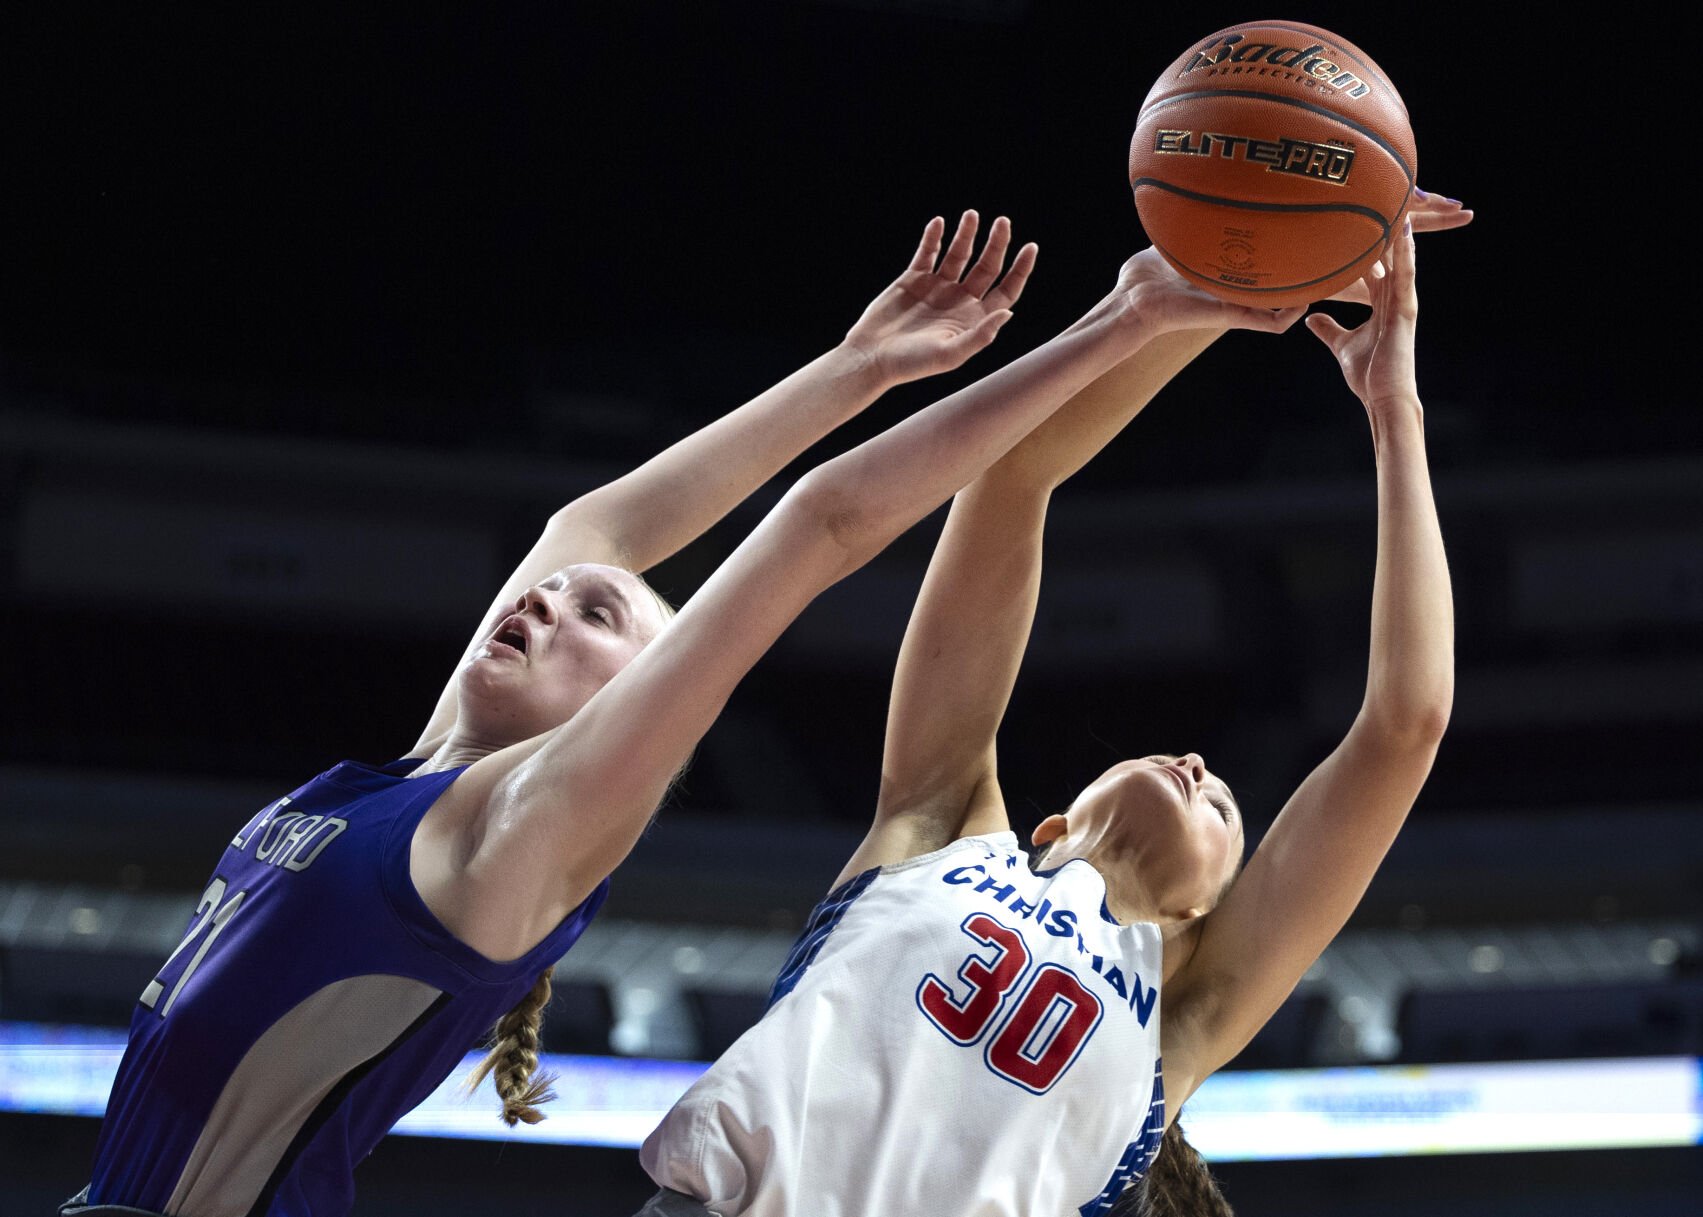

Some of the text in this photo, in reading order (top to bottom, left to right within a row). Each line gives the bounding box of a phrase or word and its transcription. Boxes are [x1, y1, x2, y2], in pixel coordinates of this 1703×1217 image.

[1178, 34, 1371, 99] Baden
[1154, 129, 1348, 179] ELITE PRO
[231, 796, 348, 872] FORD
[139, 875, 248, 1020] 21
[914, 911, 1104, 1096] 30
